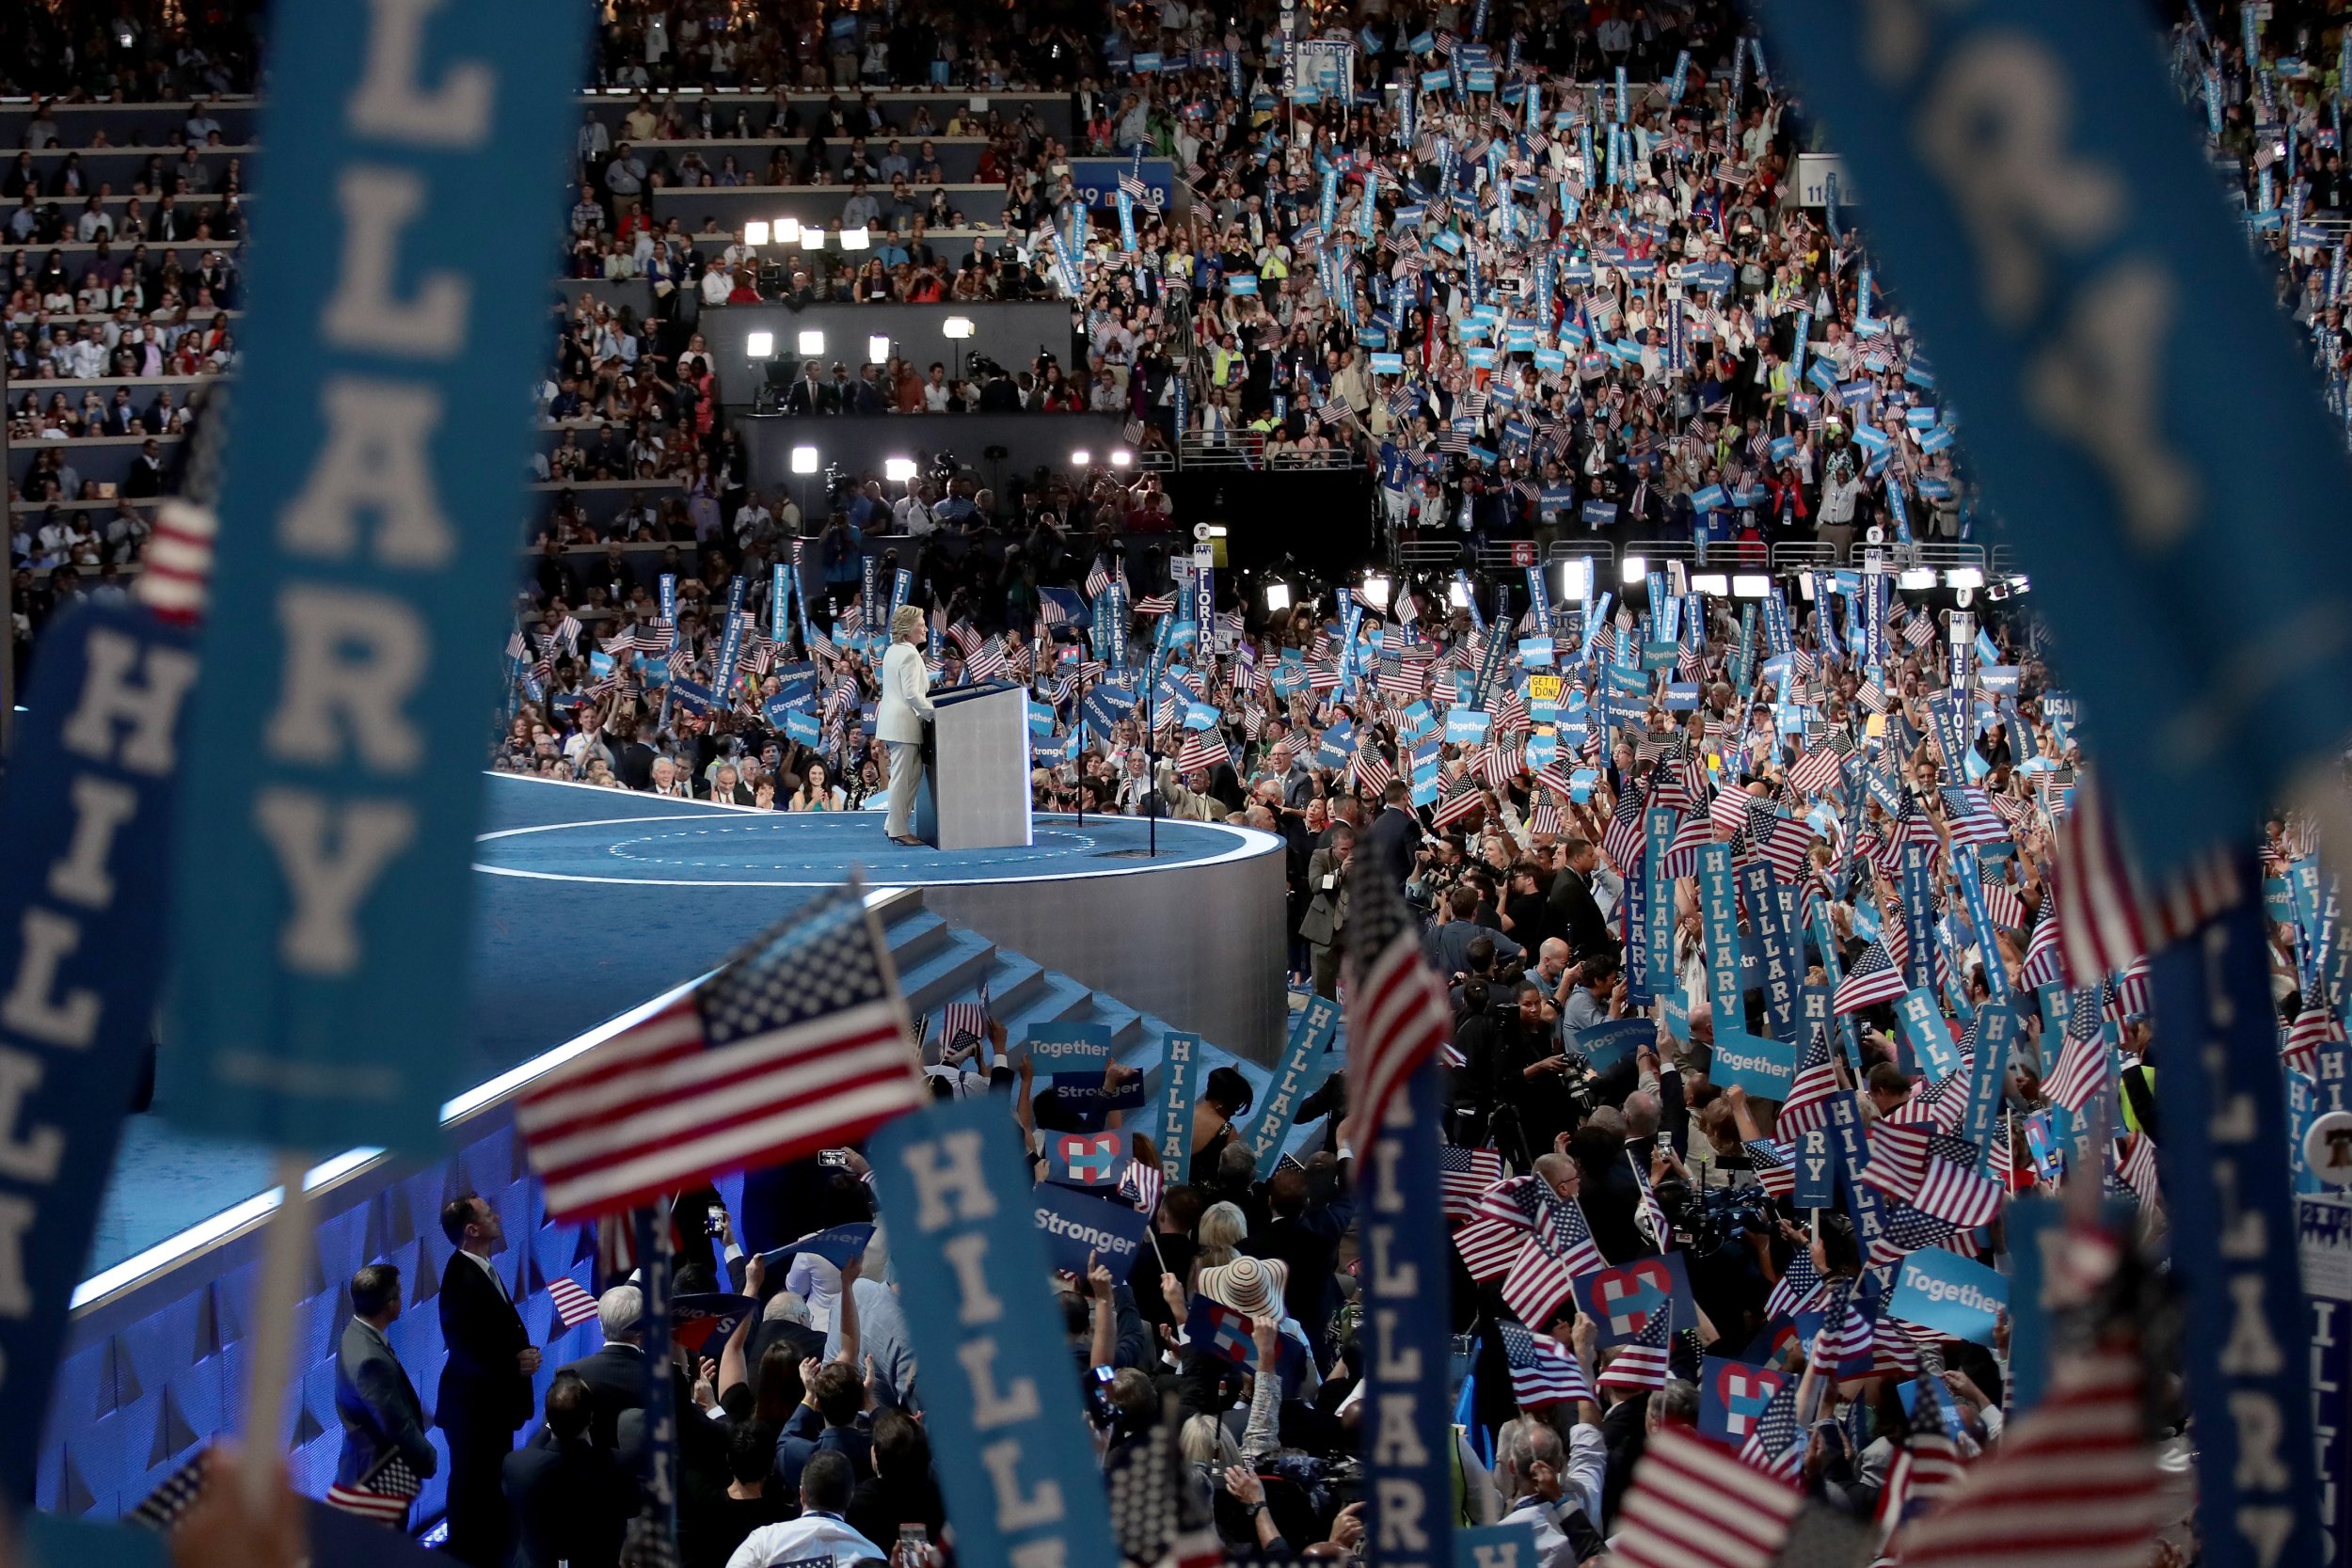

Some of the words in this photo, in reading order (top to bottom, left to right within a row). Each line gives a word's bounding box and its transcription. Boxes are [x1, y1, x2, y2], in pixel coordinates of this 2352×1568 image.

[1283, 29, 1295, 90] TEXAS
[1298, 42, 1351, 56] Histoy
[1530, 85, 1539, 126] HILLA
[1537, 267, 1549, 325] HILLARY
[1858, 272, 1869, 318] HILLAR
[776, 567, 786, 637] HILLARY
[865, 560, 874, 625] TOGETHER
[1198, 567, 1212, 656] FLORIDA
[1531, 569, 1549, 632] HILLAR
[1096, 594, 1106, 651] ILLARY
[1110, 586, 1123, 660] HILLARY
[1172, 630, 1197, 639] Togeth
[1665, 598, 1677, 642] HILL
[1766, 600, 1781, 655] HILLA
[1772, 590, 1791, 651] HILLAR
[1867, 574, 1879, 666] NEBRASKA
[717, 618, 740, 697] HILLARY
[1477, 622, 1508, 703] HILLARY
[1645, 649, 1678, 660] Together
[1740, 609, 1754, 686] HILLARY
[1763, 663, 1784, 674] Stron
[1951, 643, 1965, 689] NEW
[771, 693, 812, 714] Stronger
[779, 669, 816, 684] Stronger
[1533, 678, 1548, 687] GET
[1550, 677, 1560, 687] IT
[1535, 687, 1558, 697] DONE
[1611, 671, 1646, 689] Together
[787, 717, 818, 736] Together
[1028, 711, 1053, 724] ether
[1562, 722, 1587, 733] Strong
[1608, 707, 1647, 720] tronger
[1952, 697, 1964, 751] YOR
[1034, 746, 1064, 756] tronge
[1534, 745, 1556, 756] Togeth
[1629, 857, 1646, 986] ILLARY
[1706, 850, 1737, 1016] HILLARY
[1907, 848, 1929, 988] HILLAR
[1748, 869, 1791, 1023] HILLARY
[1664, 998, 1688, 1022] ether
[1029, 1038, 1110, 1058] Together
[1715, 1046, 1791, 1079] Together
[1163, 1039, 1190, 1183] HILLAR
[1255, 1004, 1333, 1170] HILLARY
[1805, 994, 1827, 1182] HIRY
[1971, 1015, 2007, 1155] HILL
[1834, 1099, 1893, 1290] HILLAY
[1034, 1207, 1136, 1258] Stronger
[2203, 922, 2297, 1568] ILLARY
[1905, 1265, 2006, 1314] Together
[1371, 1091, 1432, 1568] ILLAR
